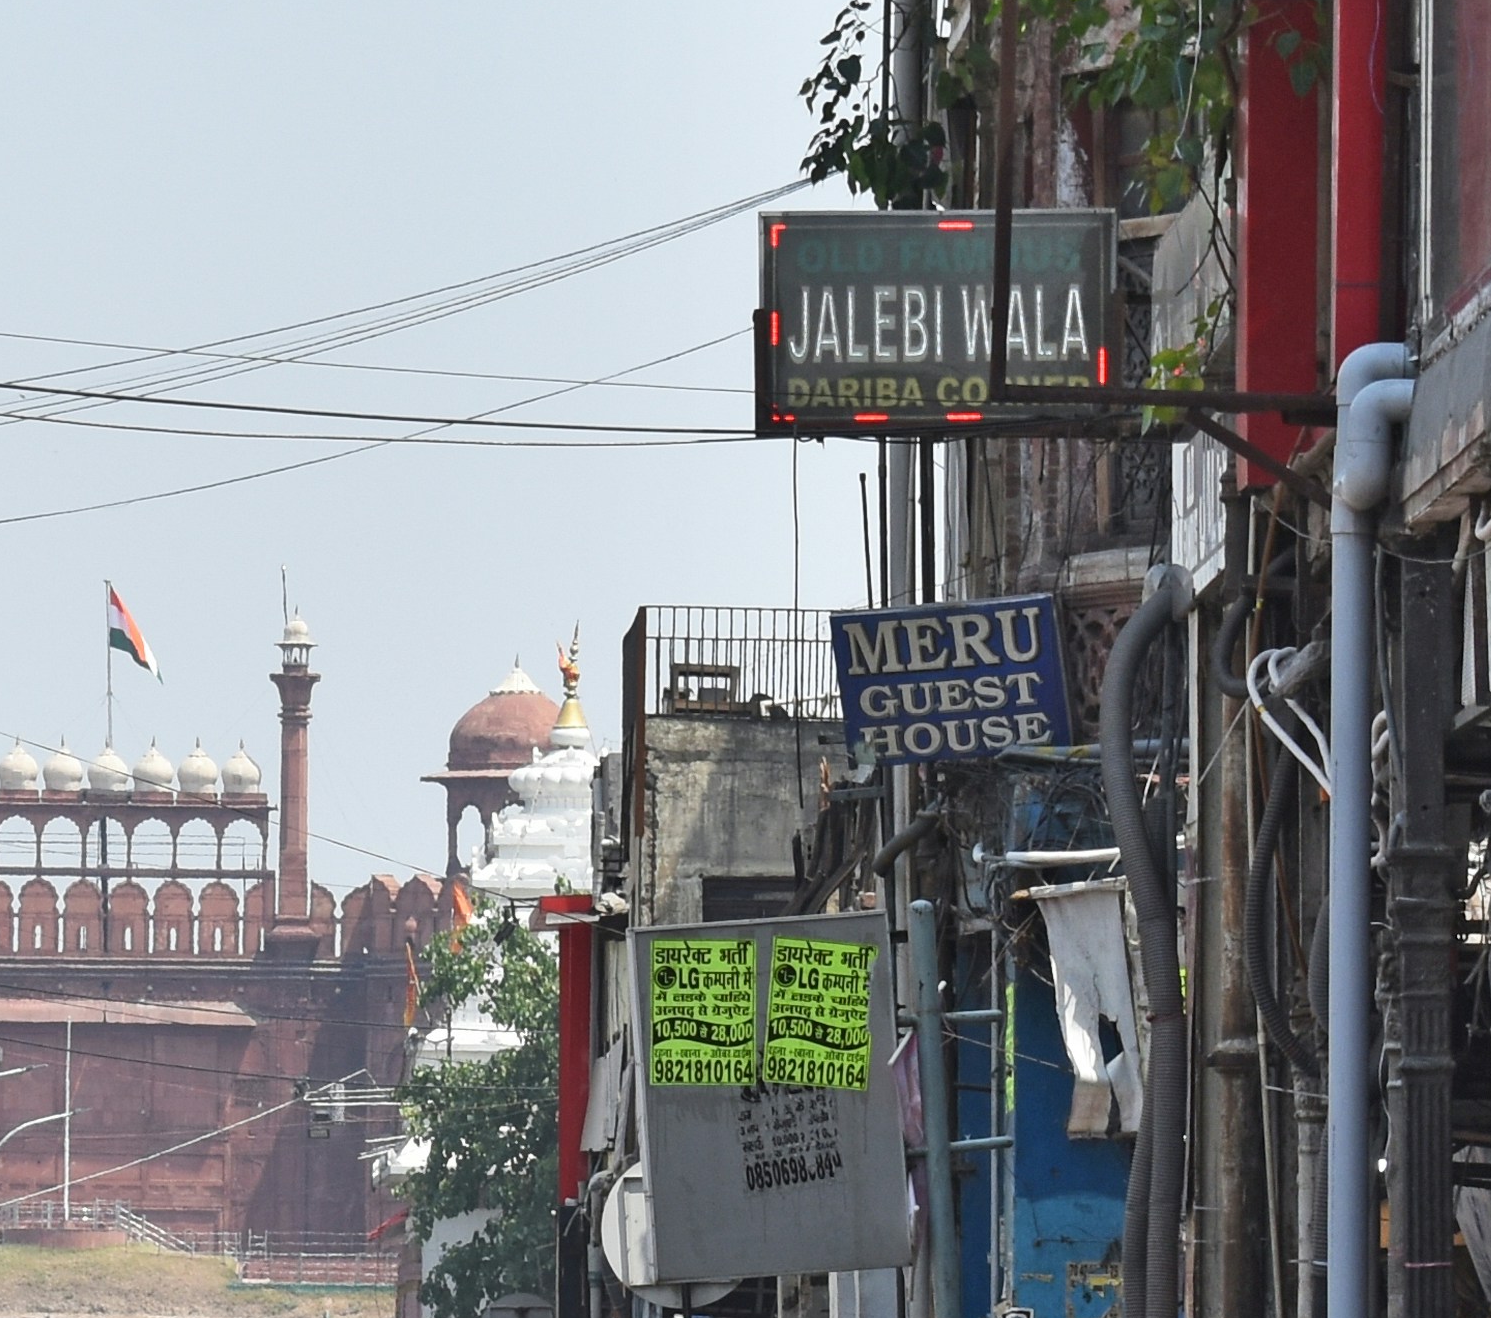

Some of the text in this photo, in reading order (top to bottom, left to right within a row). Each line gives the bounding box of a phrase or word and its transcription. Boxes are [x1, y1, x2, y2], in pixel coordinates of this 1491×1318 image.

[796, 240, 885, 274] OLD
[787, 283, 1092, 365] JALEBI WALA
[786, 376, 925, 409] DARIBA
[842, 606, 1042, 676] MERU
[859, 672, 1044, 719] GUEST
[858, 712, 1055, 758] HOUSE
[654, 940, 752, 966] डायरेक्ट भर्ती
[776, 940, 834, 967] डायरेक्ट
[678, 967, 700, 990] LG
[797, 967, 820, 991] LG
[655, 1020, 697, 1040] 10,500
[710, 1023, 753, 1045] 28,000
[770, 1018, 813, 1039] 10,500
[825, 1027, 868, 1049] 28,000
[654, 1059, 753, 1084] 9821810164
[767, 1056, 866, 1088] 9821810164
